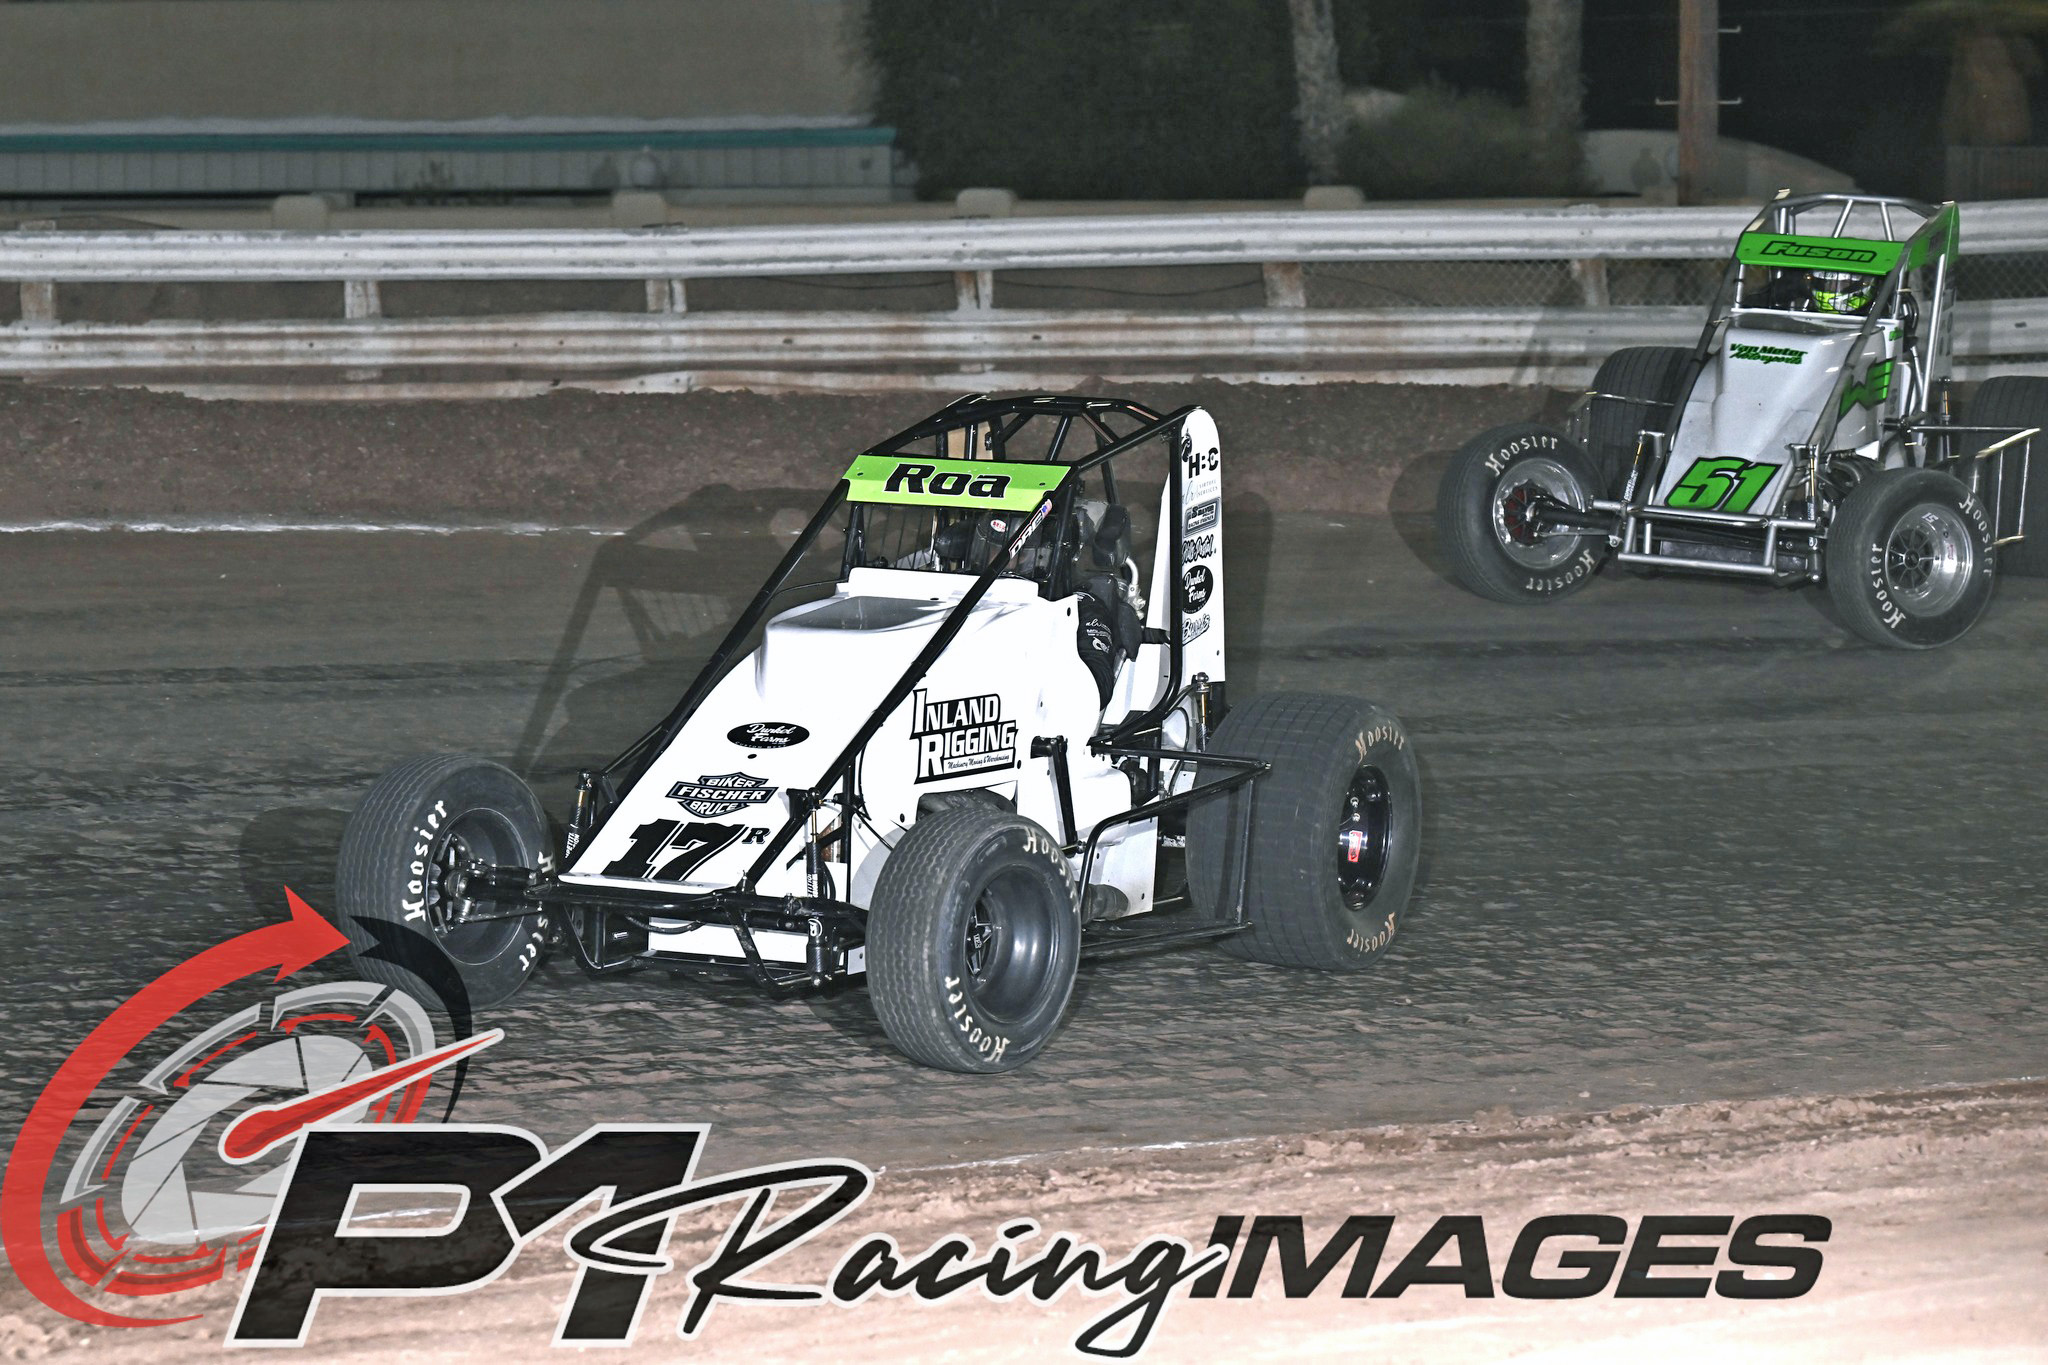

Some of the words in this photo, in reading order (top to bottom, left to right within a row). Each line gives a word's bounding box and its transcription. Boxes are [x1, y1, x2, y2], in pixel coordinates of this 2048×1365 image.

[1761, 241, 1877, 263] Fuson
[1485, 436, 1558, 477] Hoosier
[884, 463, 1011, 498] Roa
[1664, 457, 1783, 513] 51
[1958, 493, 1993, 577] Hoosier
[1525, 549, 1595, 595] Hoosier
[1870, 543, 1906, 629] Hoosier
[751, 732, 790, 743] Farms
[915, 720, 1017, 782] RIGGING
[1355, 721, 1404, 764] Hoosier
[677, 786, 767, 801] FISCHER
[707, 776, 757, 788] BIKER
[689, 801, 739, 815] BRUCE
[402, 801, 447, 922] Hoosier
[1347, 912, 1395, 953] Hoosier
[945, 976, 1010, 1062] Hoosier
